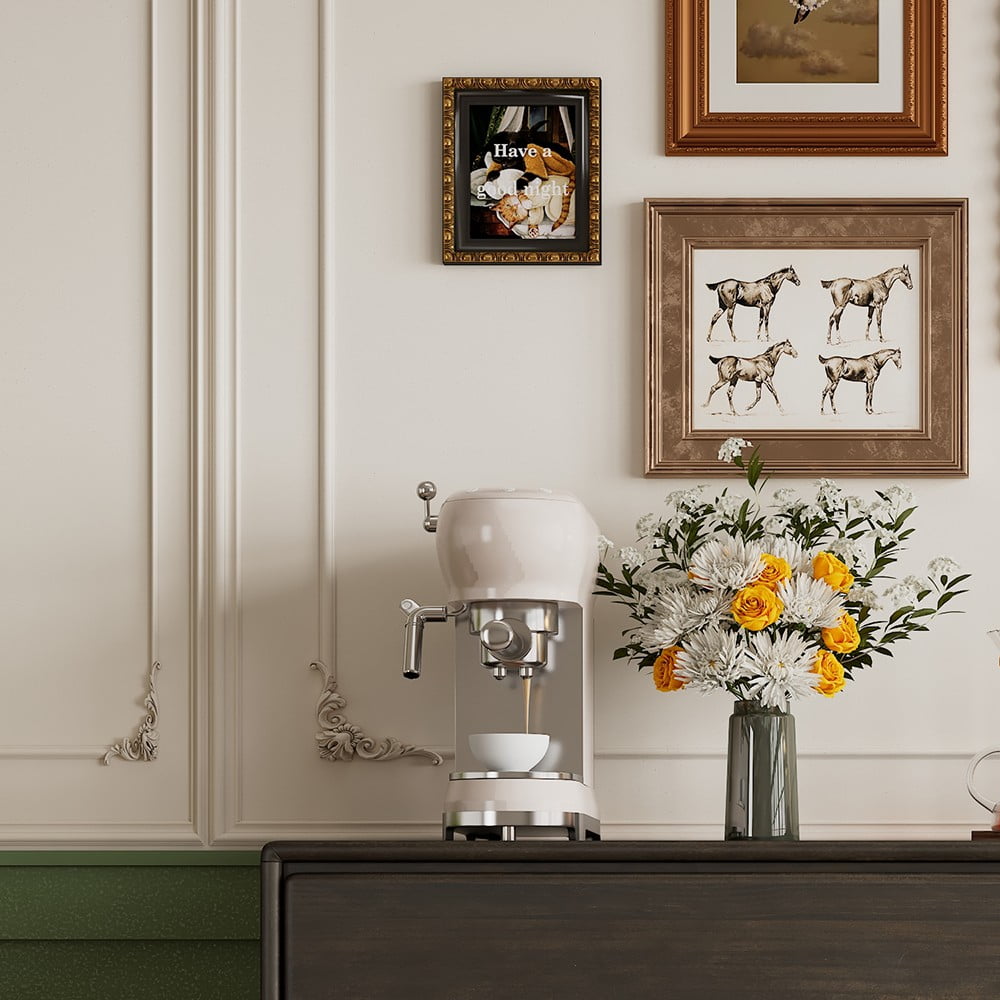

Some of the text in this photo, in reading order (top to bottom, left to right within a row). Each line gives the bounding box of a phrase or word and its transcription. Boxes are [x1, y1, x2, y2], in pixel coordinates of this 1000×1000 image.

[493, 143, 552, 158] Have a
[523, 180, 570, 200] night
